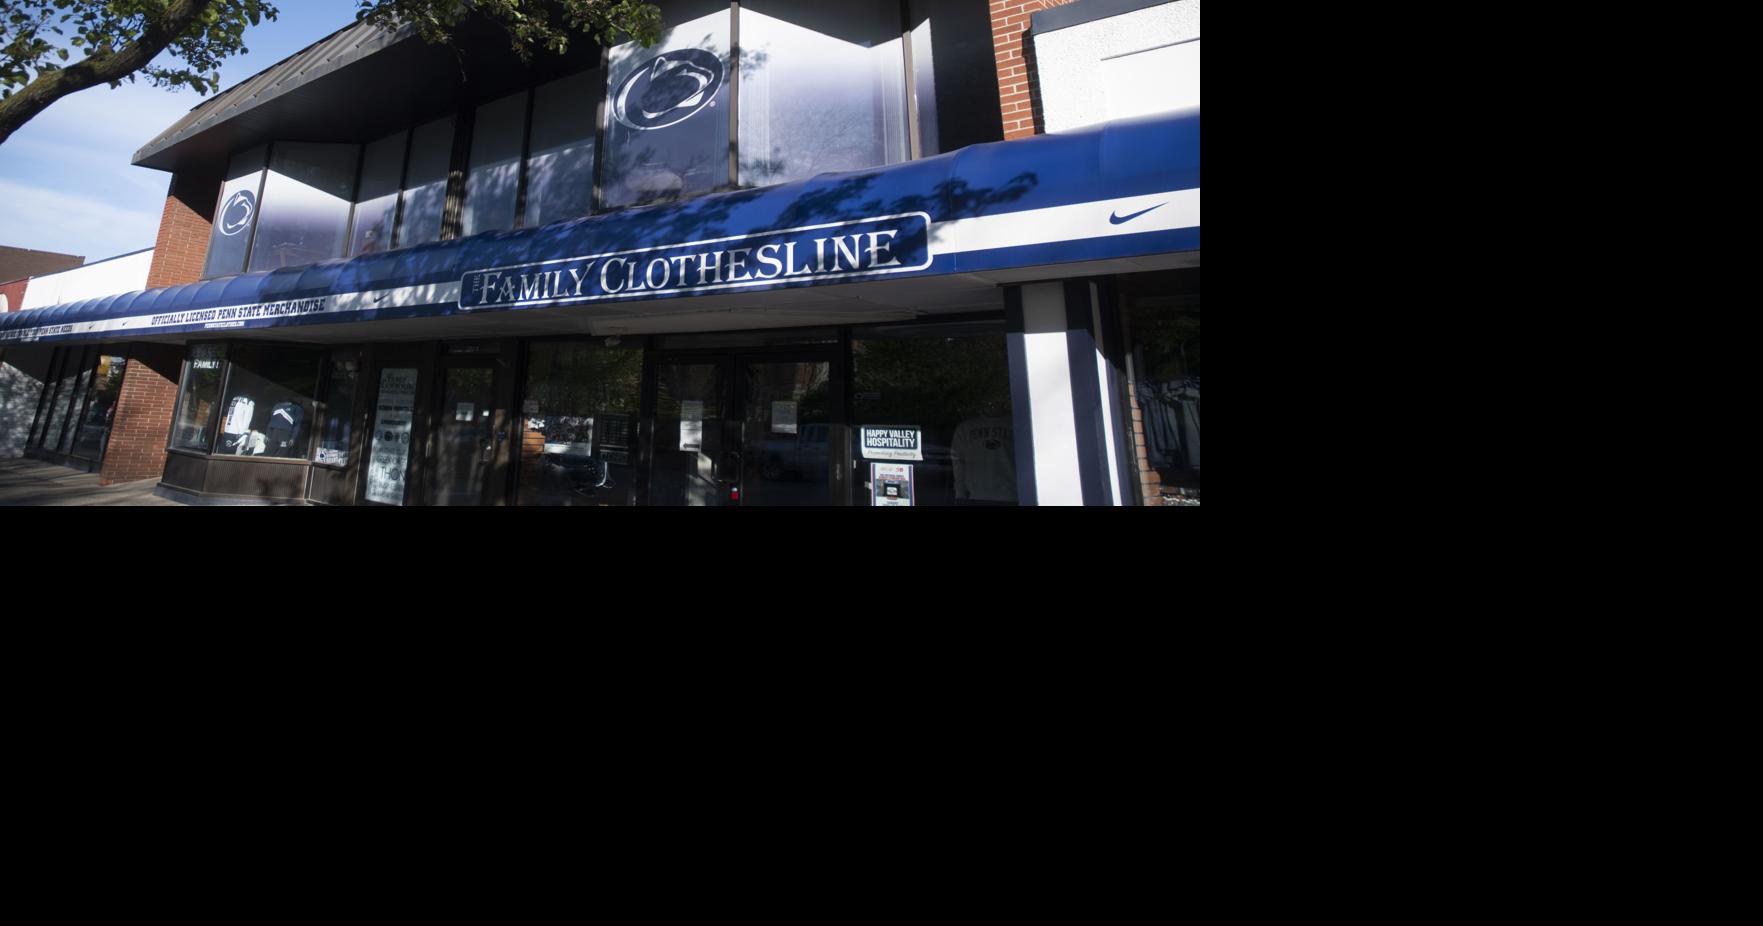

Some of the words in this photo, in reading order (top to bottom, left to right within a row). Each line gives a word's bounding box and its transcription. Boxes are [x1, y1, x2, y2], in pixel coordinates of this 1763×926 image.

[479, 260, 596, 304] FAMILY
[600, 229, 902, 293] CLOTHESLINE
[472, 273, 481, 294] THE
[151, 313, 185, 326] OFFICIALLY
[187, 310, 216, 323] LICENSED
[217, 307, 237, 320] PENN
[238, 305, 262, 318] STATE
[263, 298, 327, 316] MERCHANDISE
[866, 429, 888, 438] HAPPY
[889, 429, 915, 440] VALLEY
[866, 438, 916, 448] HOSPITALITY
